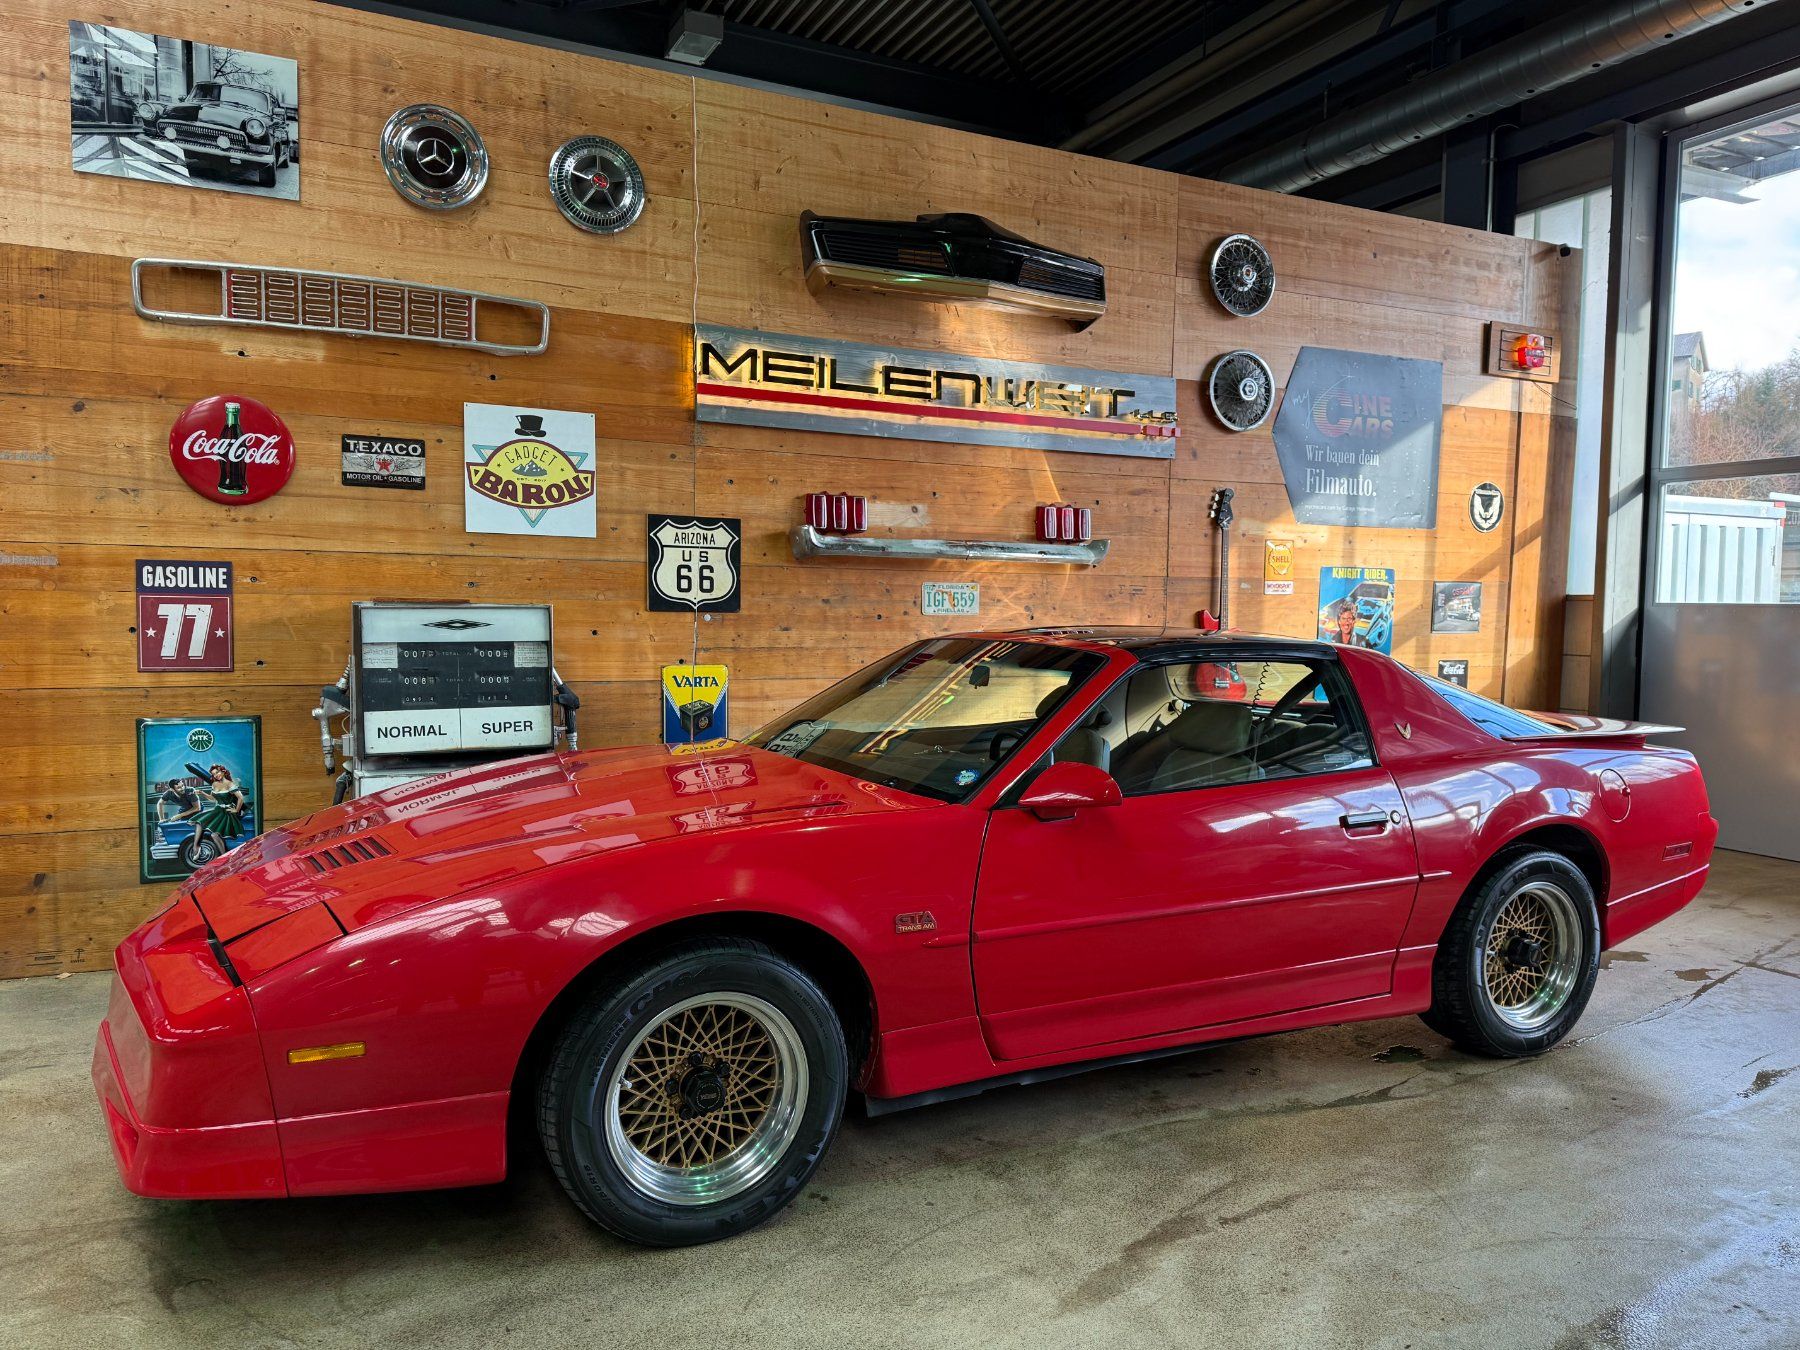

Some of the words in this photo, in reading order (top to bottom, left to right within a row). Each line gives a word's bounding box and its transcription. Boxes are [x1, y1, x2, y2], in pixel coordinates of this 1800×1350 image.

[182, 430, 281, 465] Coca-Cola
[345, 439, 422, 456] TEXACO
[504, 445, 558, 467] GADGET
[1305, 444, 1324, 462] Wir
[1326, 450, 1356, 466] bauen
[388, 475, 422, 484] GASOLINE
[474, 468, 590, 505] BARON
[1305, 468, 1377, 497] Filmauto.
[673, 532, 716, 545] ARIZONA
[142, 565, 228, 589] GASOLINE
[676, 565, 715, 593] 66
[1332, 567, 1362, 579] KNIGHT
[157, 603, 214, 660] 77
[672, 675, 719, 688] VARTA
[377, 724, 447, 739] NORMAL
[481, 720, 533, 735] SUPER
